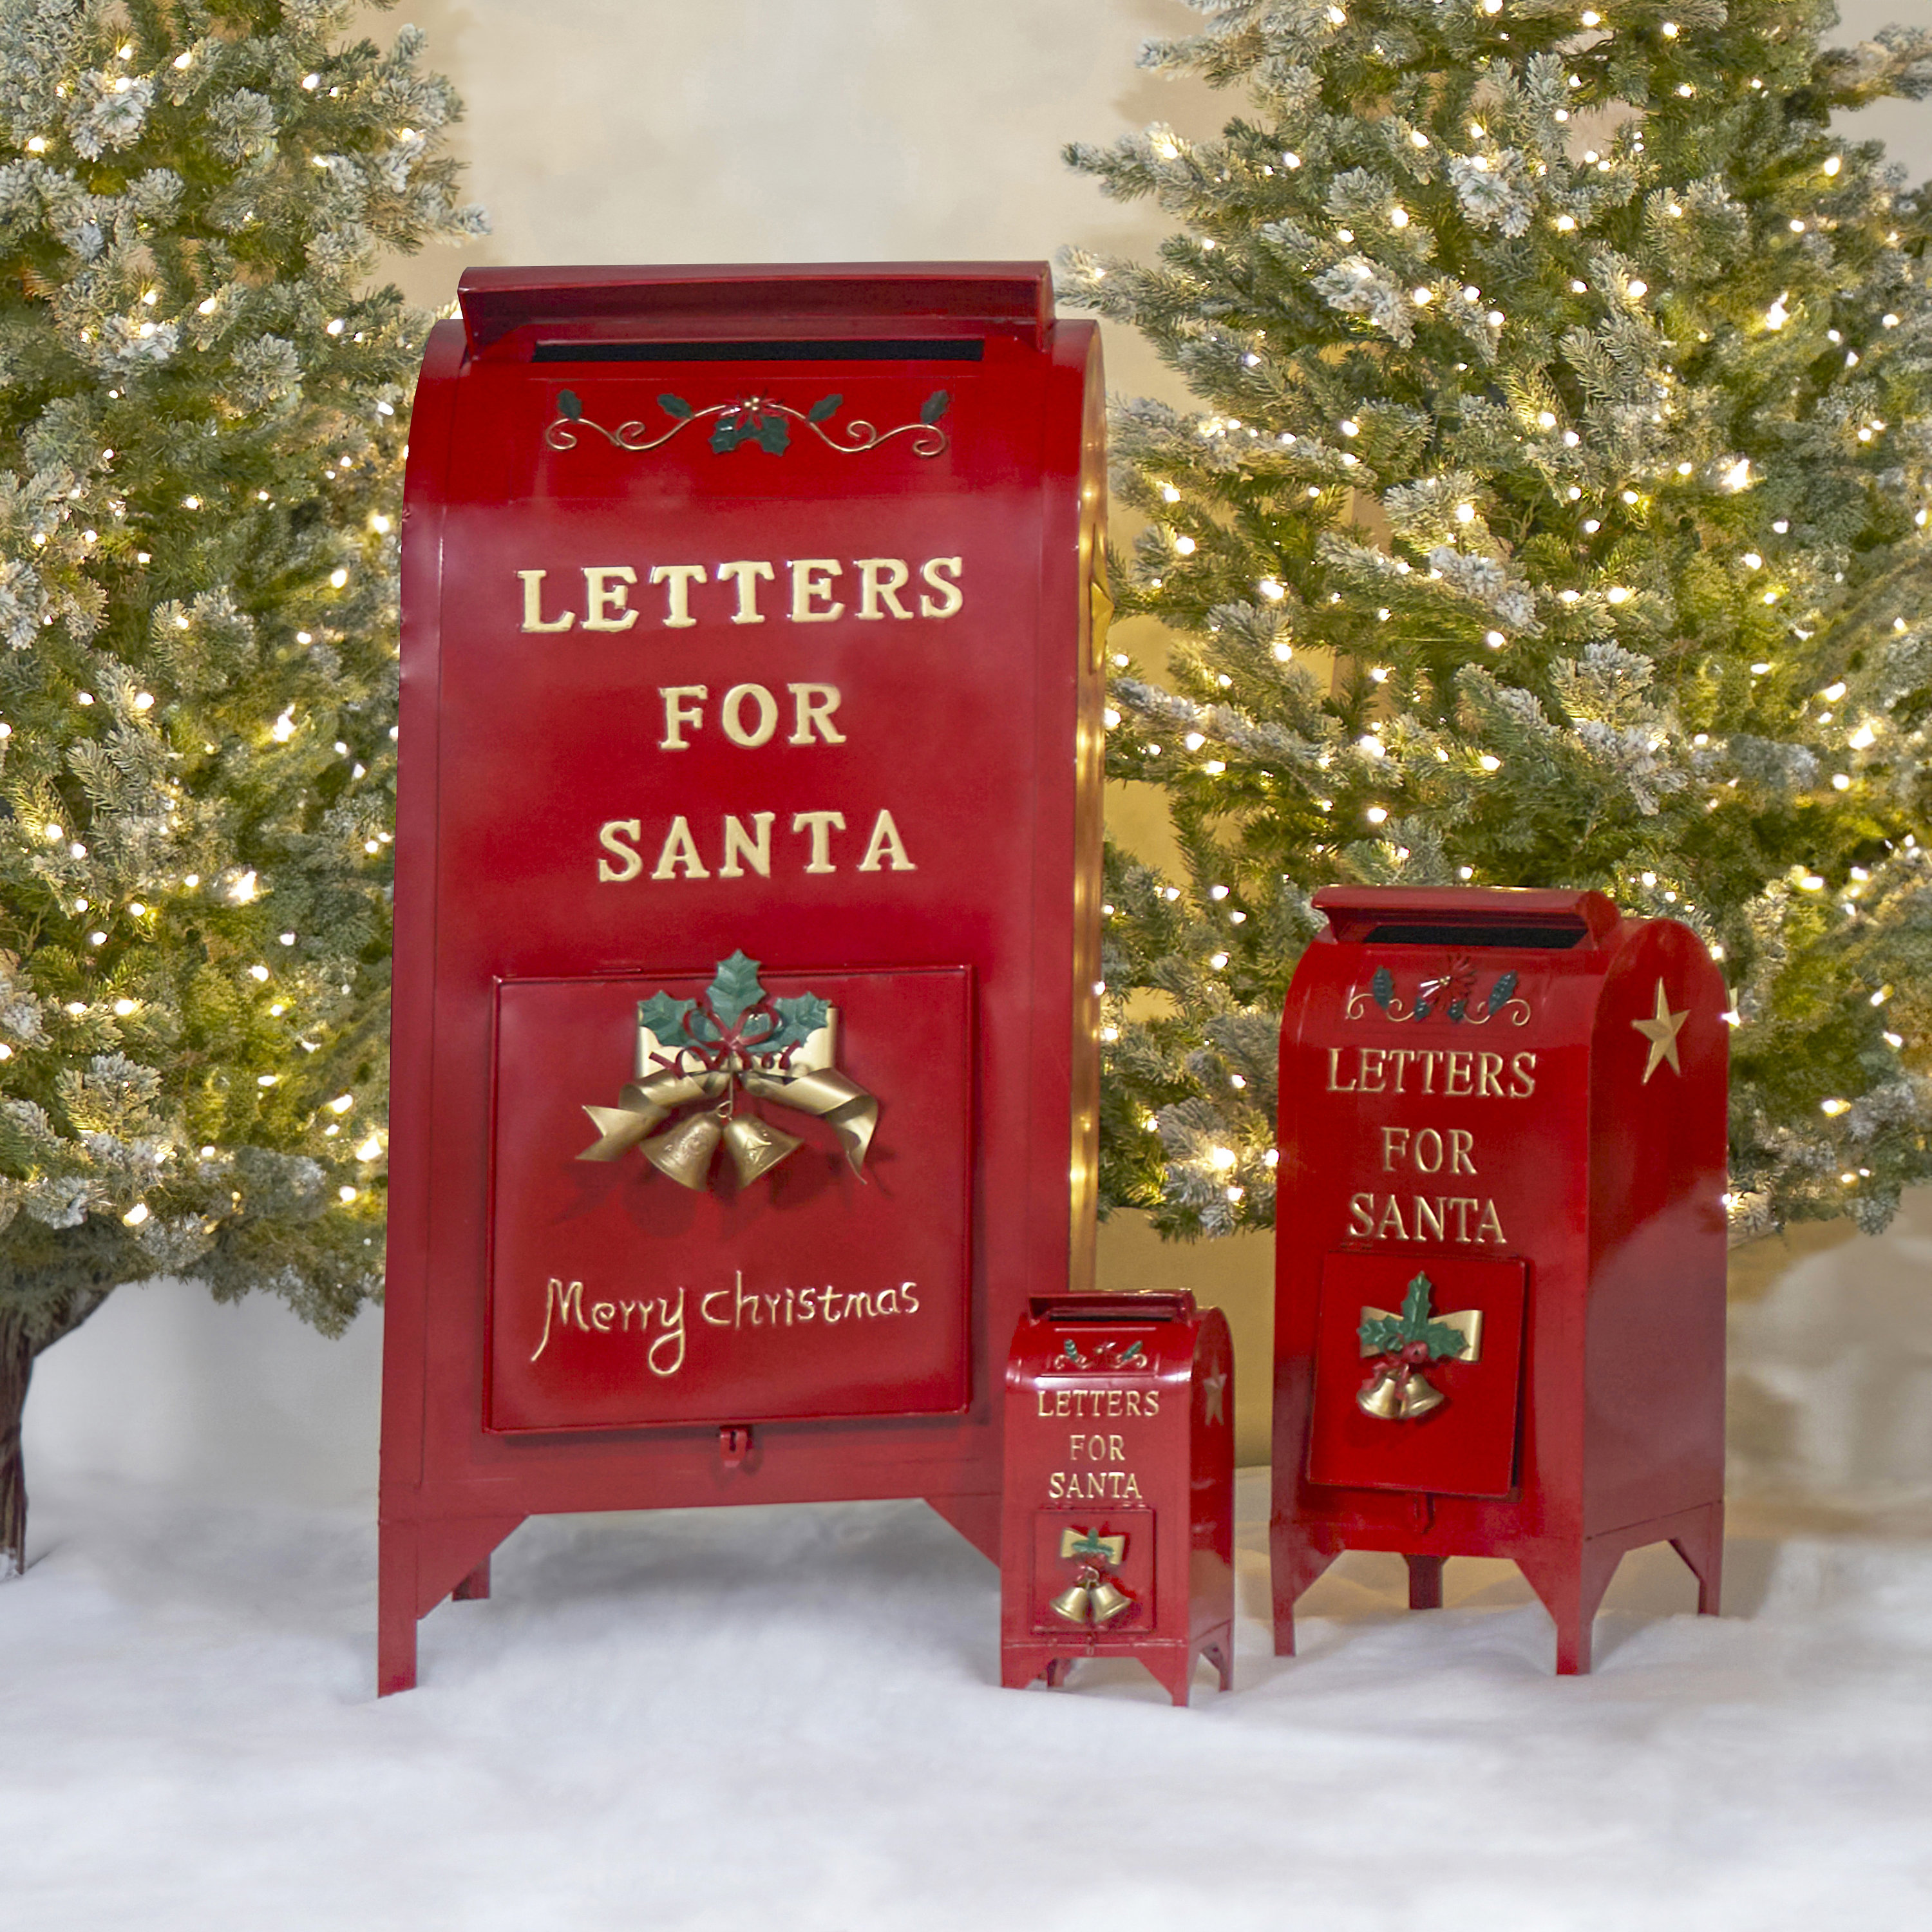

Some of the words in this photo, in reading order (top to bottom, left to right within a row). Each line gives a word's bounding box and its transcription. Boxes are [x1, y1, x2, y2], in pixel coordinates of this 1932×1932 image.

[516, 556, 963, 633] LETTERS
[659, 683, 847, 750] FOR
[598, 809, 918, 883] SANTA
[1327, 1048, 1537, 1099] LETTERS
[1381, 1126, 1478, 1175] FOR
[1349, 1192, 1507, 1244] SANTA
[530, 1278, 686, 1376] Merry
[1037, 1389, 1160, 1417] LETTERS
[1070, 1434, 1125, 1461] FOR
[1048, 1472, 1142, 1499] SANTA
